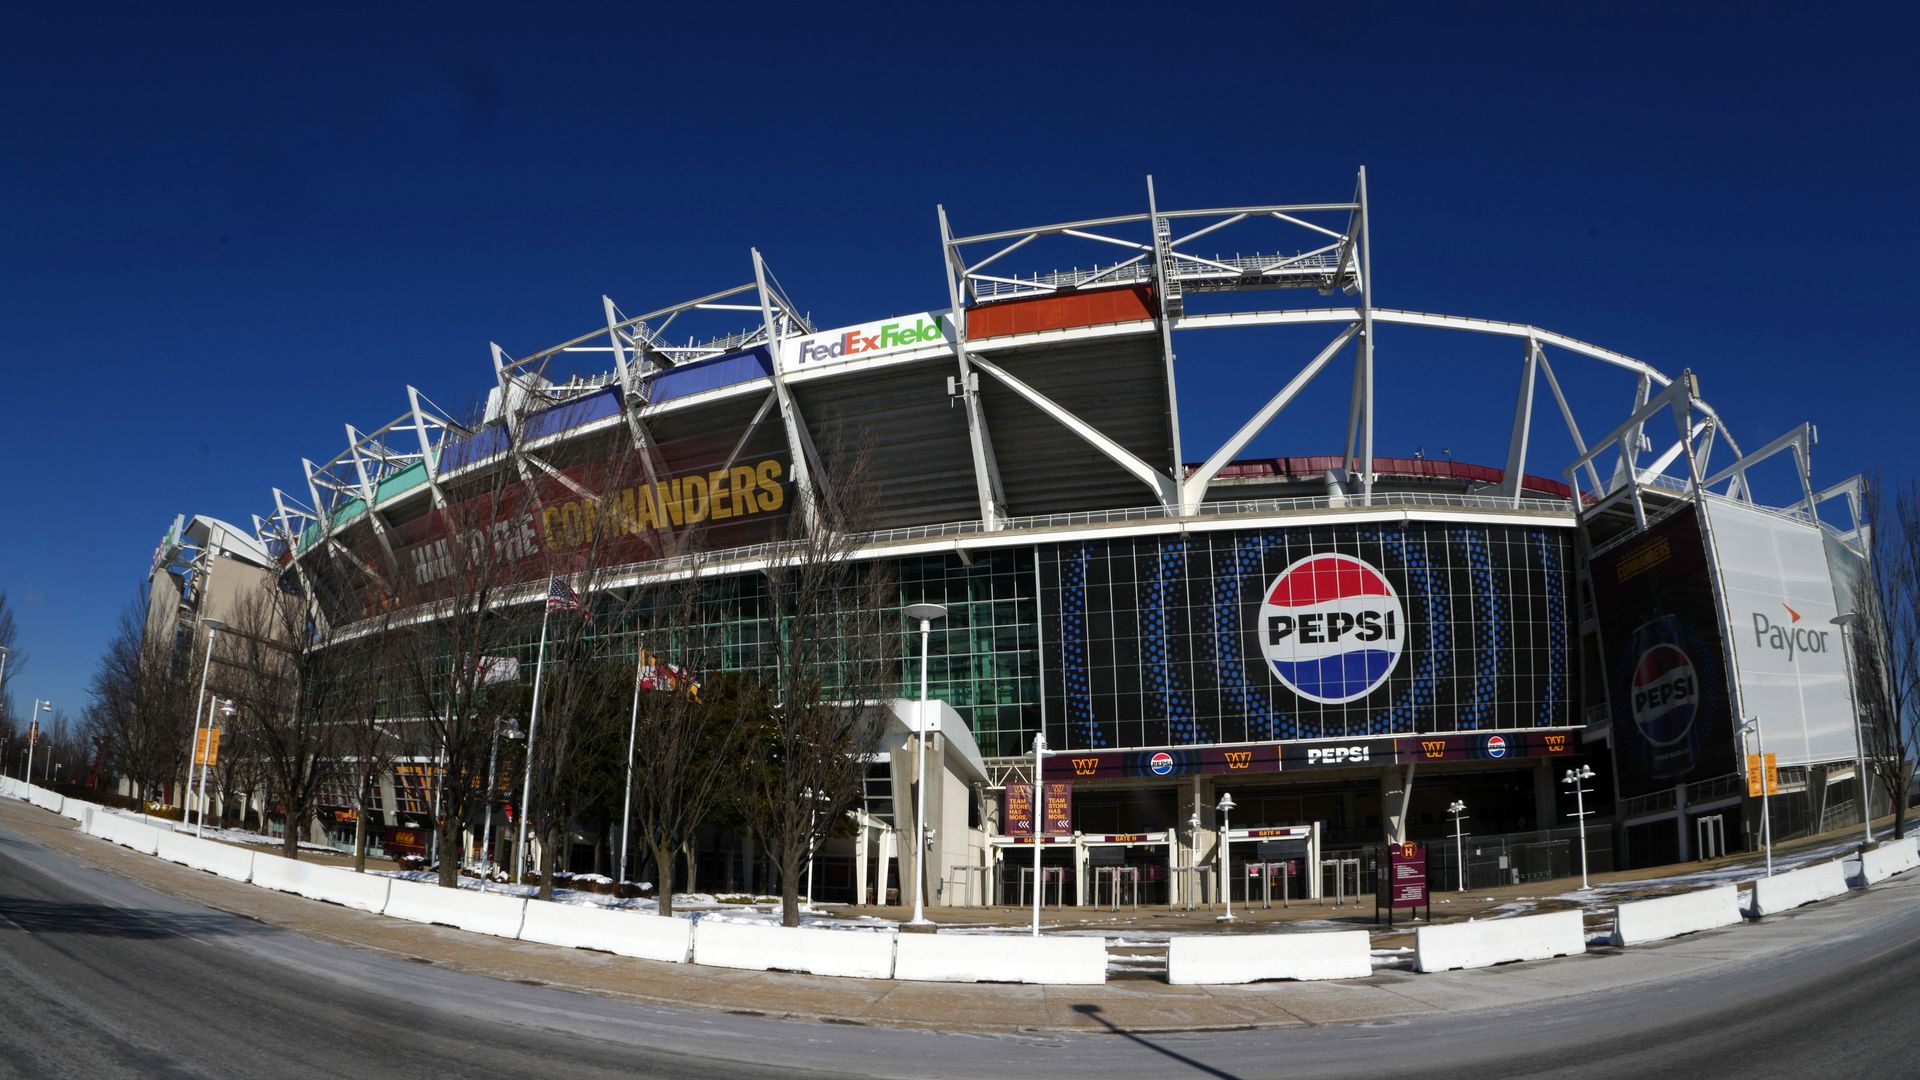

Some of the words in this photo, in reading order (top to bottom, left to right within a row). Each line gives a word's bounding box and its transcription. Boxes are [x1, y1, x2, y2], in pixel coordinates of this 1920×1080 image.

[799, 315, 943, 364] FedExField
[542, 458, 785, 550] COMMANDERS
[1267, 610, 1396, 646] PEPSI
[1752, 612, 1829, 662] Paycor
[1634, 674, 1695, 713] PEPSI
[1307, 746, 1370, 765] PEPSI
[1405, 847, 1413, 857] H
